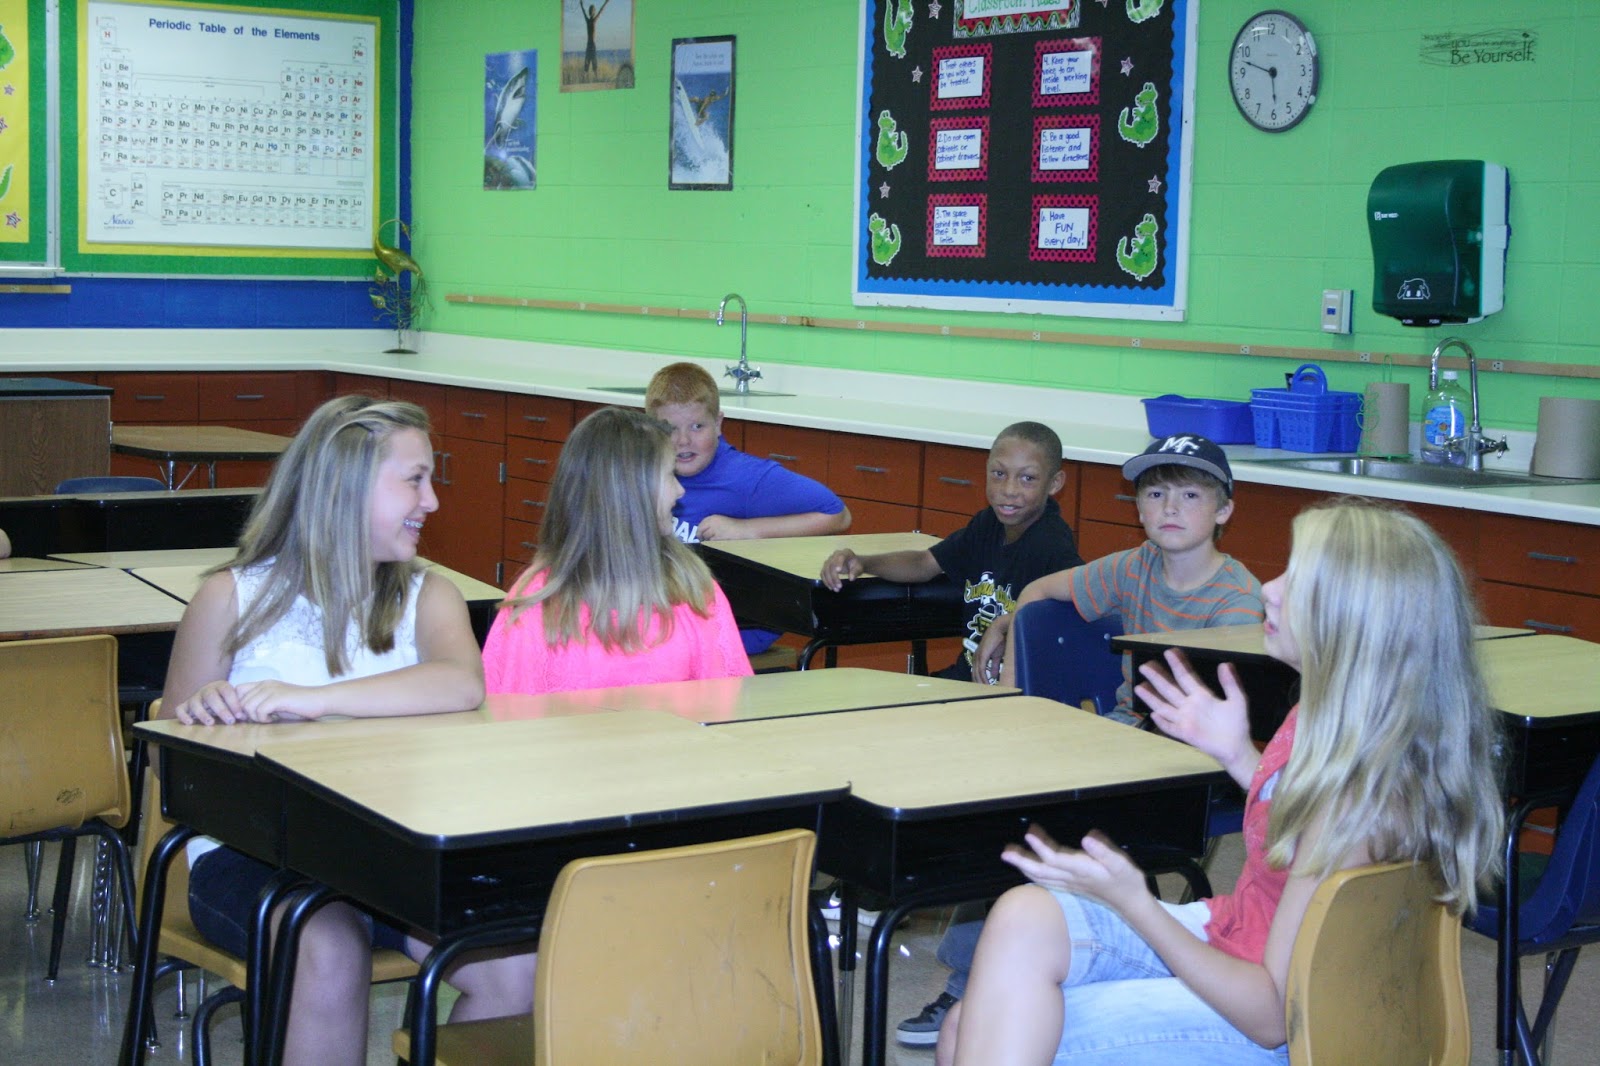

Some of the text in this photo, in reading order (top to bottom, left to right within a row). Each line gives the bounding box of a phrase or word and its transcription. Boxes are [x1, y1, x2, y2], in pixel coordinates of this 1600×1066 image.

[149, 18, 320, 41] Periodic Table of the Elements
[1267, 23, 1276, 35] 12
[1241, 44, 1302, 58] 10 2
[1451, 40, 1535, 65] Be Yourself.
[1240, 65, 1306, 79] 9 3
[1245, 87, 1302, 100] 8 4
[1256, 102, 1292, 115] 7 5
[1270, 109, 1277, 120] 6
[1055, 222, 1074, 234] FUN
[1044, 231, 1085, 249] every day!
